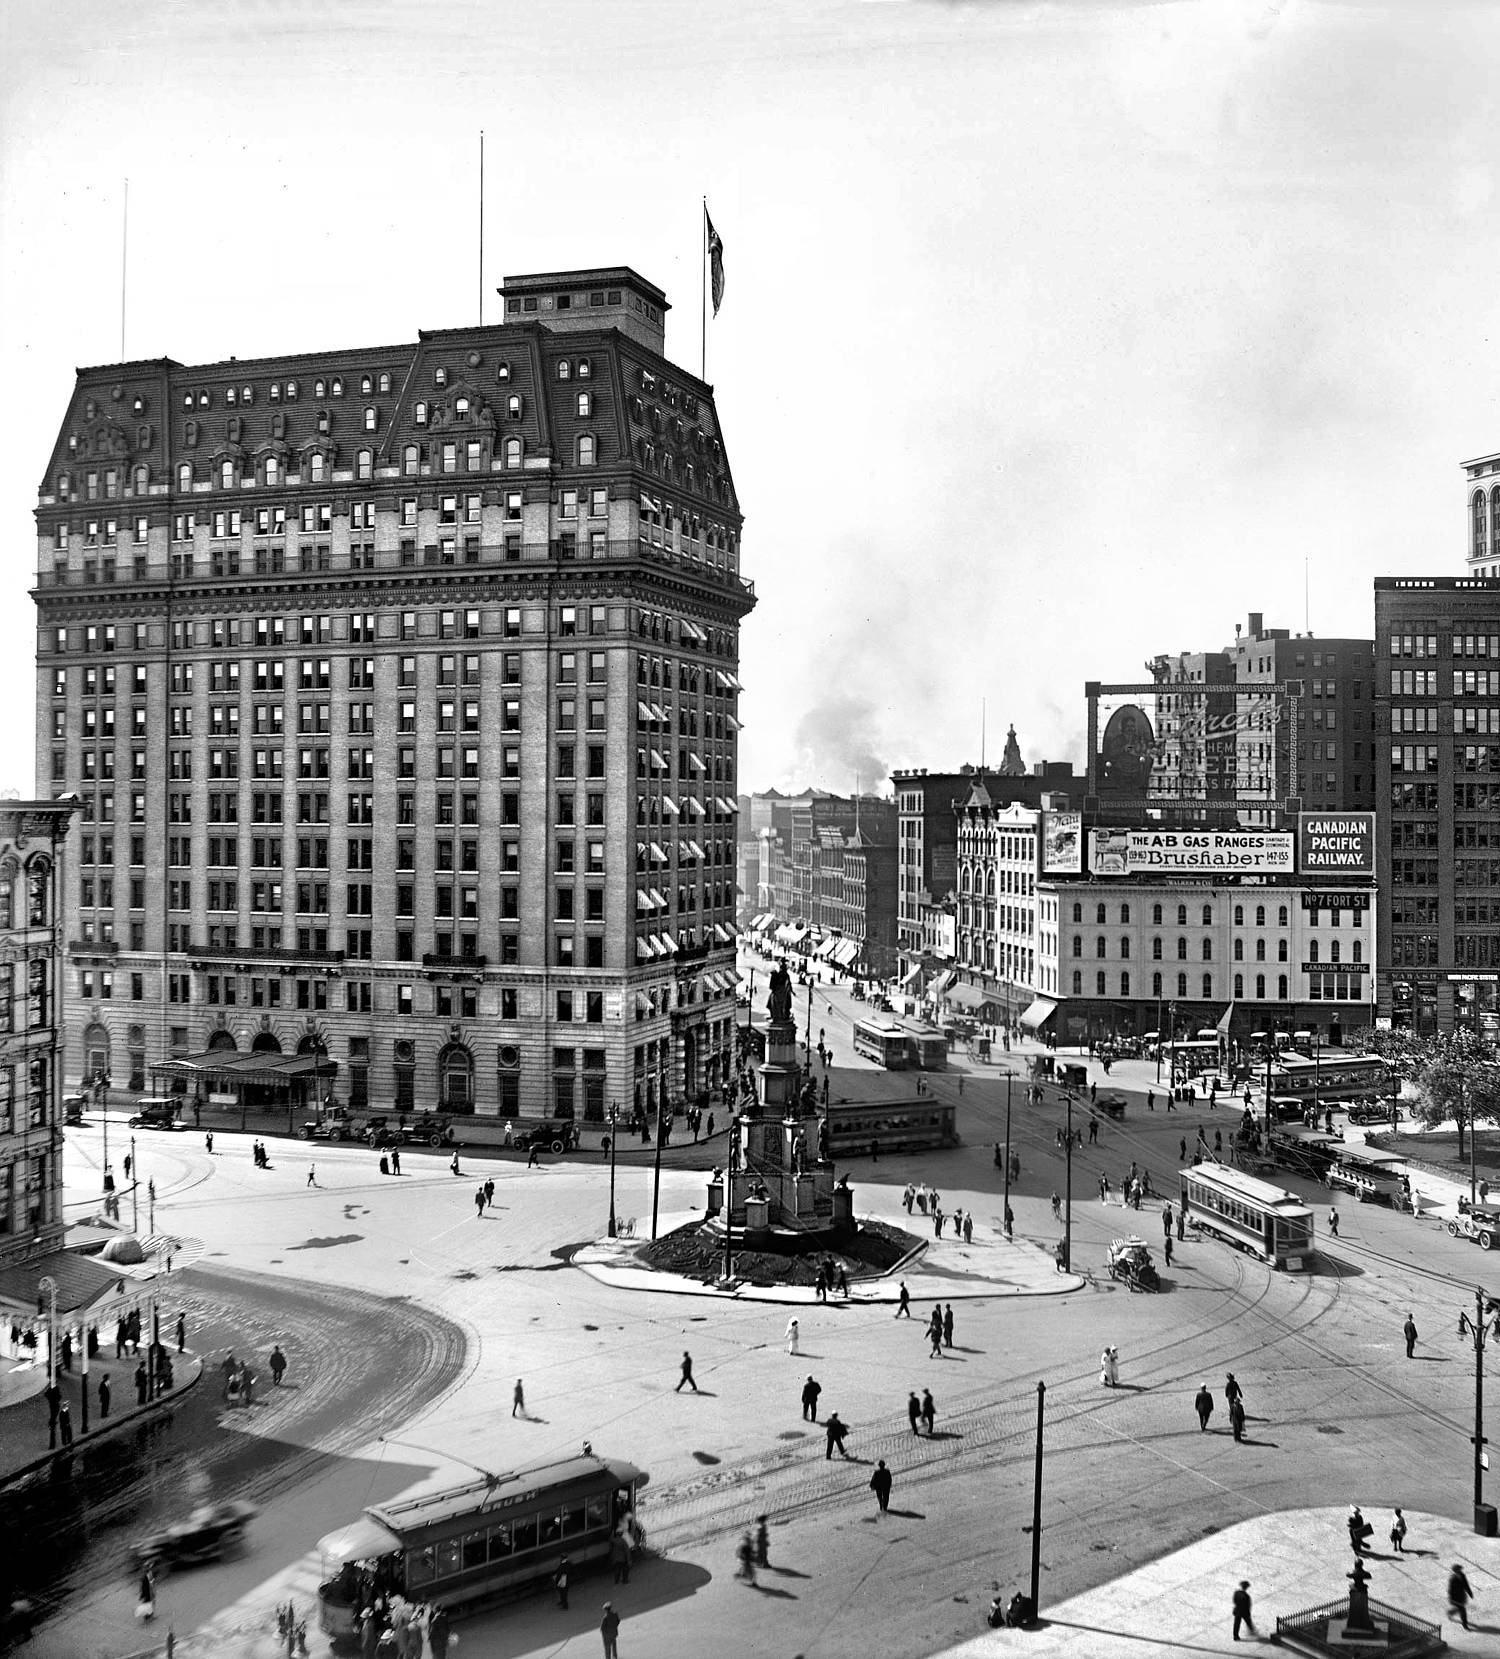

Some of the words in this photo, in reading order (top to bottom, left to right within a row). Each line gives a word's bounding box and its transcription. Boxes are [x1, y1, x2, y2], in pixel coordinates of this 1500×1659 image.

[1307, 821, 1367, 834] CANADIAN
[1132, 837, 1148, 846] THE
[1183, 836, 1210, 848] GAS
[1215, 836, 1265, 848] RANGES
[1312, 837, 1360, 850] PACIFIC
[1147, 850, 1265, 865] Brushaber
[1307, 853, 1364, 865] RAILWAY.
[1318, 895, 1325, 906] 7
[1327, 895, 1351, 907] FORT
[1304, 964, 1338, 972] CANADIAN
